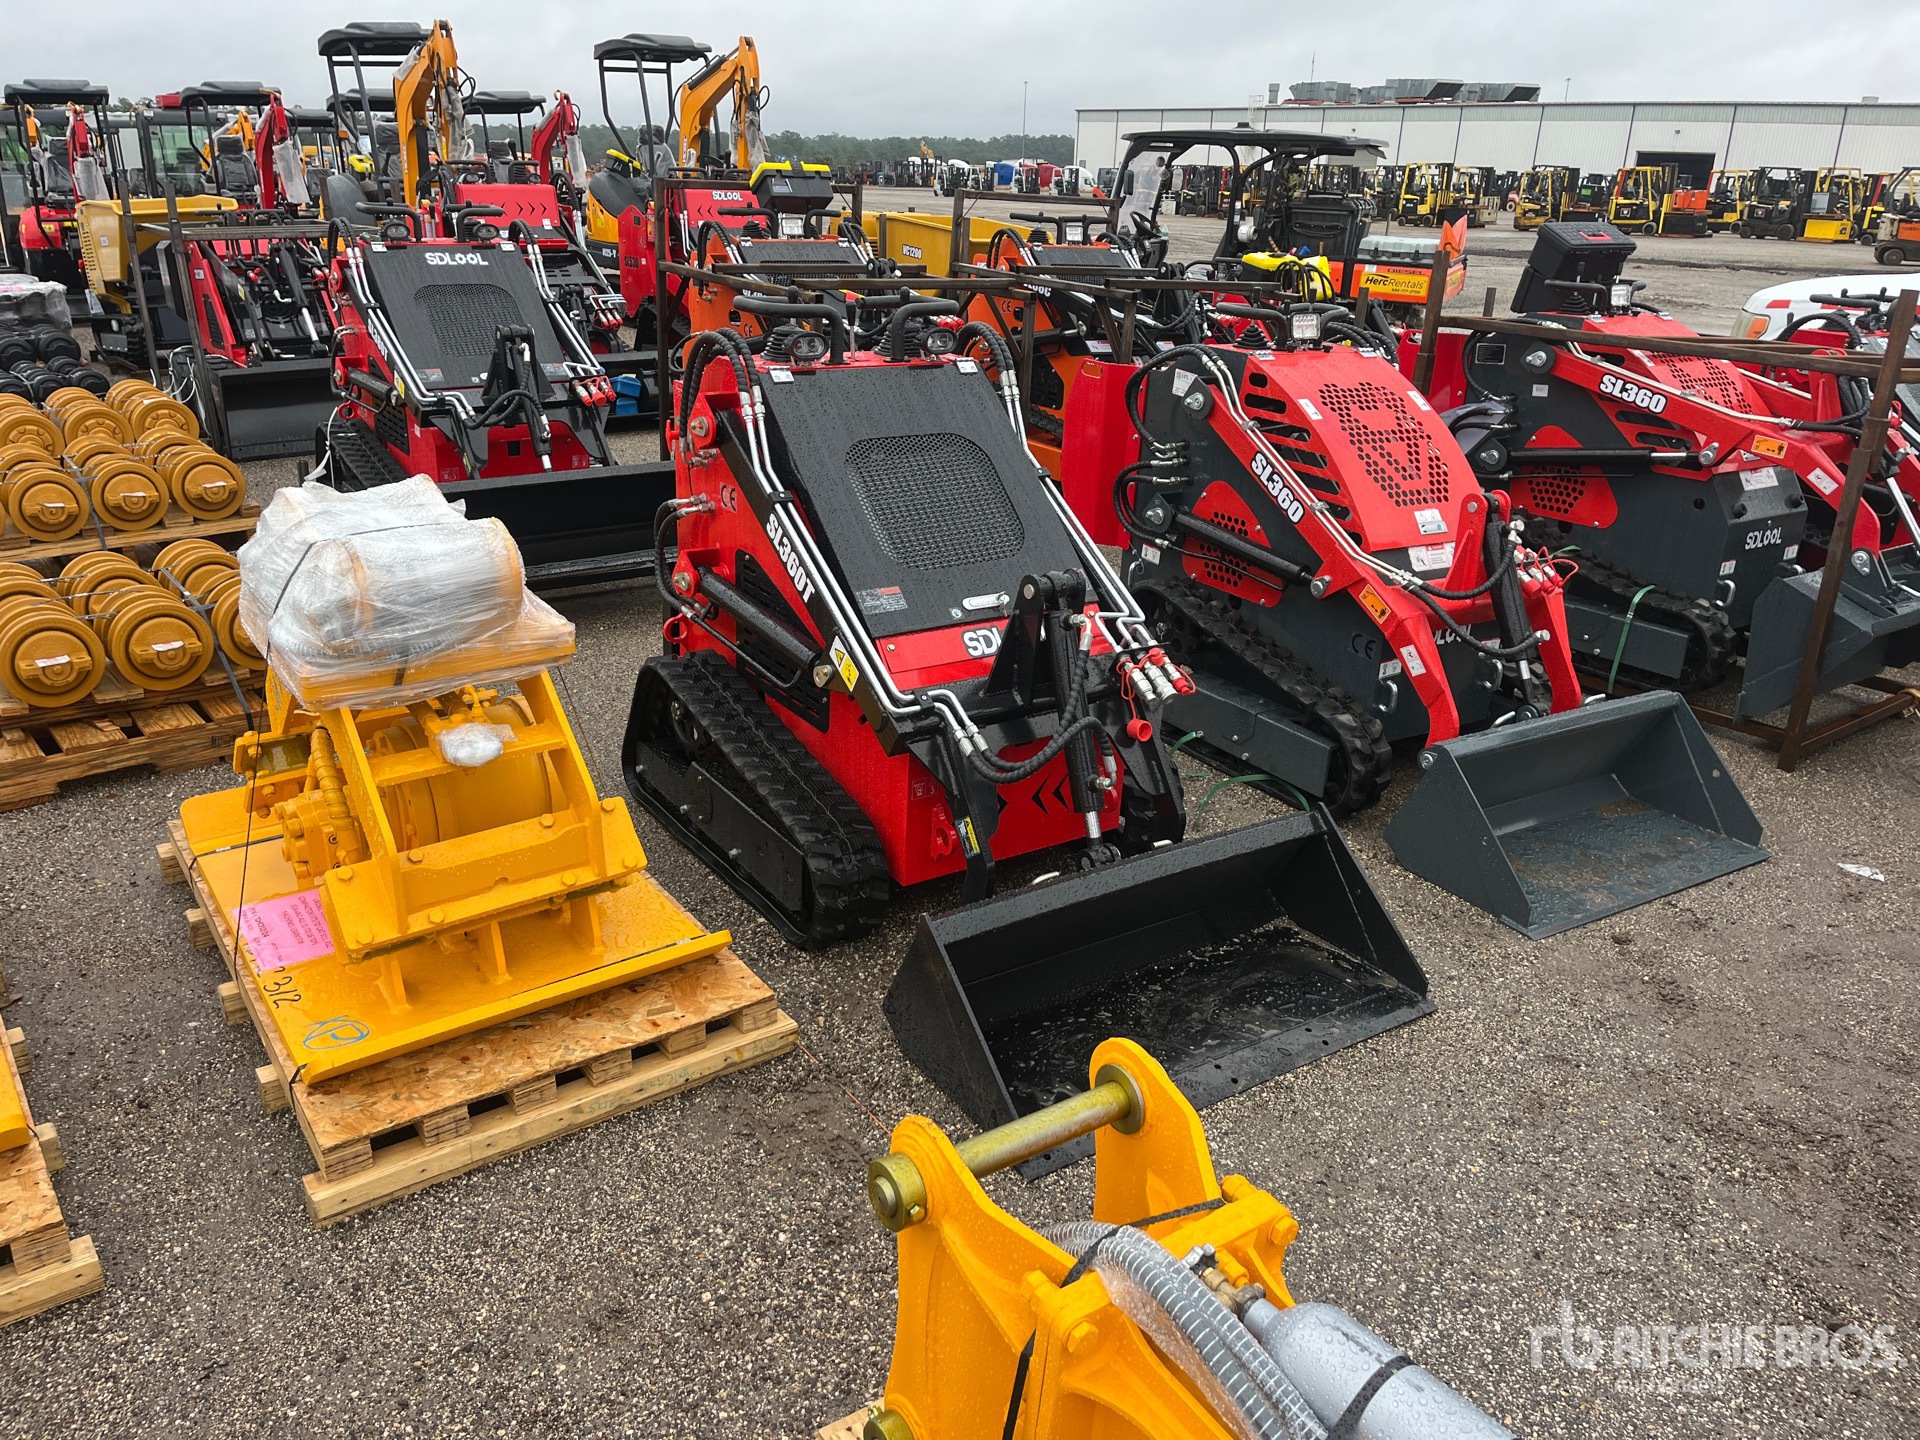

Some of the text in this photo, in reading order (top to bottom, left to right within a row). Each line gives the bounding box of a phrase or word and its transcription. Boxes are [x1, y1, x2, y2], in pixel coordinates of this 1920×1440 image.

[712, 190, 743, 201] SDLOOL
[425, 252, 489, 265] SDLOOL
[1598, 373, 1668, 414] SL360
[1250, 451, 1305, 524] SL360
[1744, 526, 1782, 550] SDLOOL
[766, 513, 816, 604] SL360T
